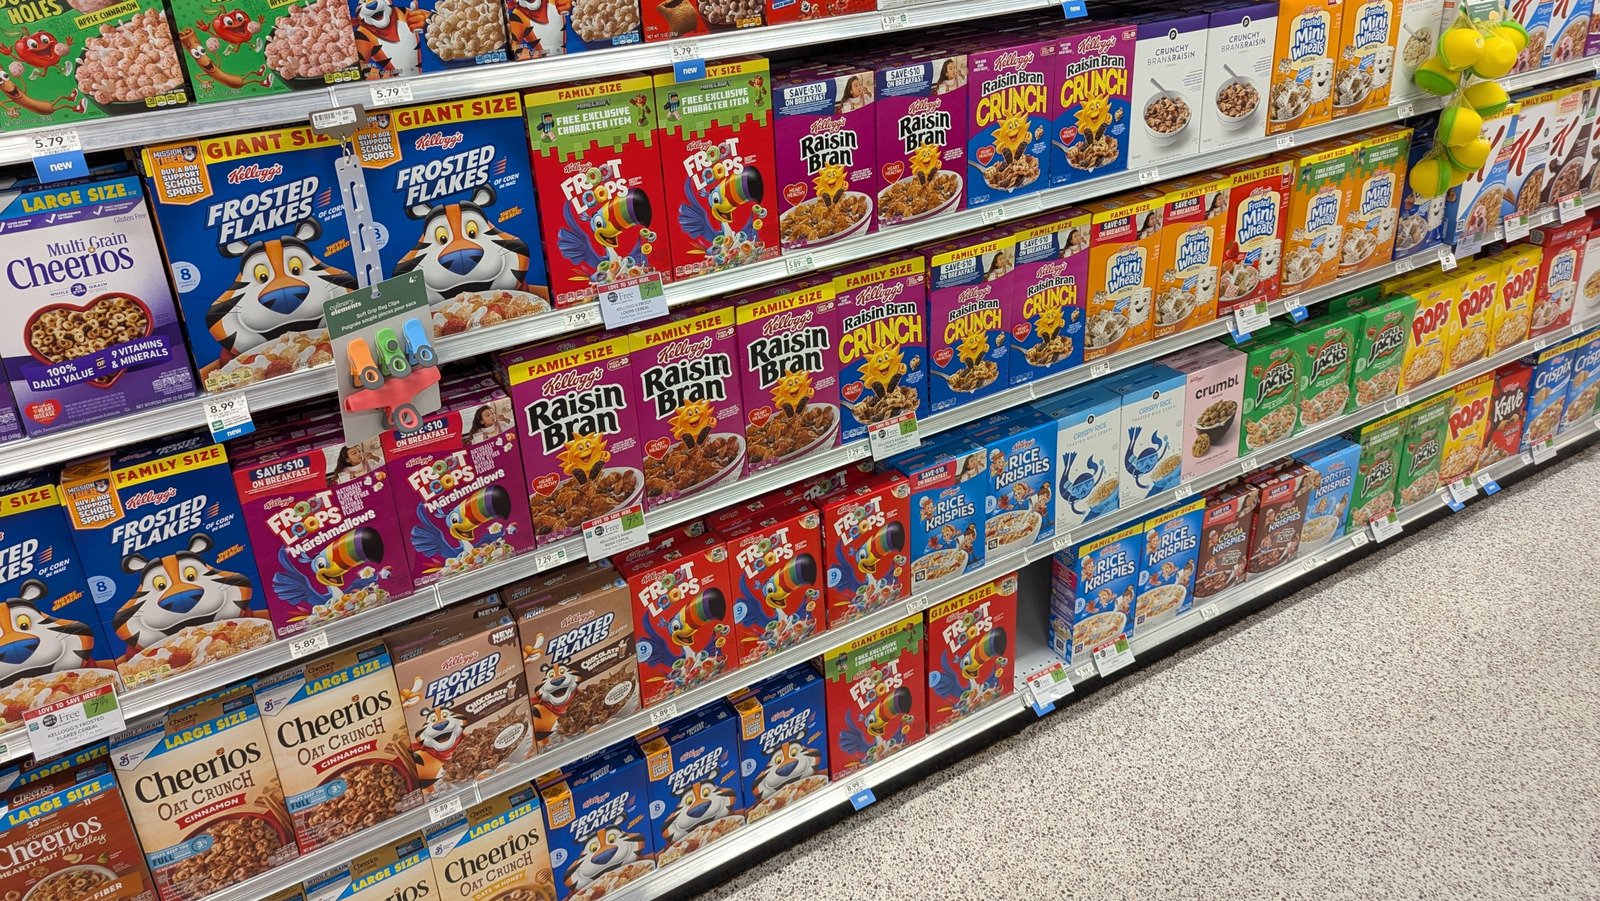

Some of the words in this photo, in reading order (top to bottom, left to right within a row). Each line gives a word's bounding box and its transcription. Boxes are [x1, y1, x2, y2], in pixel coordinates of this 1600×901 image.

[78, 14, 99, 27] APPLE
[99, 2, 138, 20] CINNAMON
[1365, 6, 1385, 17] Frosted
[1300, 16, 1321, 28] Frosted
[1360, 13, 1387, 32] Mini
[1229, 31, 1260, 43] CRUNCHY
[1295, 25, 1325, 44] Mini
[1356, 29, 1387, 48] Wheats
[673, 46, 692, 57] 5.79
[1155, 44, 1189, 56] CRUNCHY
[1292, 41, 1325, 61] Wheats
[683, 66, 697, 75] new
[721, 65, 742, 77] SIZE
[891, 70, 906, 80] SAVE
[1067, 59, 1099, 77] Raisin
[1101, 55, 1124, 67] Bran
[558, 87, 596, 100] FAMILY
[599, 83, 622, 95] SIZE
[789, 87, 806, 98] SAVE
[808, 85, 822, 94] $10
[897, 76, 923, 87] BREAKFAST
[982, 75, 1017, 95] Raisin
[1018, 71, 1043, 85] Bran
[1060, 69, 1127, 107] CRUNCH
[376, 87, 400, 99] 5.79
[682, 95, 702, 106] FREE
[704, 88, 748, 102] EXCLUSIVE
[796, 93, 826, 105] BREAKFAST
[1540, 94, 1553, 104] SIZE
[398, 103, 463, 127] GIANT
[471, 96, 518, 120] SIZE
[682, 101, 728, 115] CHARACTER
[730, 96, 750, 107] ITEM
[976, 86, 1047, 128] CRUNCH
[557, 114, 580, 126] FREE
[582, 107, 631, 122] EXCLUSIVE
[557, 121, 608, 136] CHARACTER
[609, 116, 632, 127] ITEM
[899, 111, 950, 138] Raisin
[35, 136, 63, 148] 5.79
[207, 133, 281, 160] GIANT
[359, 136, 392, 147] SUPPORT
[361, 142, 393, 154] SCHOOL
[801, 130, 857, 158] Raisin
[905, 129, 947, 154] Bran
[152, 149, 182, 159] MISSION
[362, 150, 395, 162] SPORTS
[683, 137, 739, 177] FROOT
[50, 160, 72, 171] new
[161, 167, 174, 176] BUY
[183, 164, 199, 173] BOX
[396, 145, 495, 190] FROSTED
[692, 157, 744, 191] LOOPS
[1233, 170, 1261, 184] FAMILY
[1263, 166, 1279, 177] SIZE
[162, 170, 200, 183] SUPPORT
[164, 177, 202, 191] SCHOOL
[405, 165, 490, 207] FLAKES
[494, 178, 502, 186] OF
[503, 173, 520, 183] CORN
[560, 159, 621, 201] FROOT
[22, 190, 82, 213] LARGE
[87, 183, 127, 202] SIZE
[166, 185, 204, 198] SPORTS
[207, 176, 319, 226] FROSTED
[571, 179, 628, 215] LOOPS
[1248, 197, 1270, 210] Frosted
[114, 215, 134, 223] Gluten
[134, 212, 147, 221] Free
[218, 199, 313, 245] FLAKES
[1243, 207, 1274, 226] Mini
[1238, 222, 1274, 244] Wheats
[47, 237, 86, 257] Multi
[89, 232, 128, 252] Grain
[951, 249, 976, 261] FAMILY
[979, 243, 997, 254] SIZE
[7, 246, 134, 290] Cheerios
[846, 270, 887, 288] FAMILY
[890, 263, 912, 277] SIZE
[1503, 266, 1537, 311] POPS
[329, 299, 354, 311] culinary
[331, 301, 362, 316] elements
[356, 311, 367, 319] Soft
[367, 307, 377, 316] Grip
[378, 303, 388, 312] Bag
[388, 299, 400, 308] Clips
[378, 310, 394, 319] pinces
[394, 305, 405, 313] pour
[752, 298, 795, 317] FAMILY
[798, 290, 822, 305] SIZE
[949, 304, 976, 321] Raisin
[979, 299, 998, 310] Bran
[1458, 282, 1497, 328] POPS
[567, 313, 586, 323] 7.99
[844, 306, 885, 331] Raisin
[886, 301, 916, 316] Bran
[944, 309, 1002, 343] CRUNCH
[1412, 300, 1452, 346] POPS
[645, 326, 691, 345] FAMILY
[695, 315, 722, 331] SIZE
[839, 315, 922, 360] CRUNCH
[1380, 326, 1399, 342] APPLE
[111, 349, 118, 358] 9
[118, 339, 163, 357] VITAMINS
[111, 359, 119, 368] &
[120, 348, 168, 367] MINERALS
[749, 327, 828, 371] Raisin
[47, 362, 77, 377] 100%
[97, 360, 105, 368] OF
[528, 355, 581, 376] FAMILY
[584, 345, 613, 361] SIZE
[32, 376, 59, 389] DAILY
[62, 367, 95, 382] VALUE
[644, 354, 729, 400] Raisin
[1267, 363, 1288, 379] APPLE
[1535, 359, 1572, 389] Crispix
[1195, 374, 1239, 400] crumbl
[1256, 368, 1294, 408] JACKS
[210, 401, 235, 414] 8.99
[527, 386, 624, 432] Raisin
[226, 427, 241, 437] new
[1073, 425, 1094, 440] CRISPY
[1095, 421, 1108, 433] RICE
[396, 440, 407, 448] ON
[256, 464, 282, 478] SAVE
[287, 459, 304, 471] $10
[1008, 447, 1040, 470] RICE
[117, 460, 177, 484] FAMILY
[252, 479, 265, 488] ON
[266, 467, 311, 486] BREAKFAST
[996, 458, 1050, 490] KRISPIES
[425, 469, 505, 514] Marshmallows
[112, 495, 207, 544] FROSTED
[122, 512, 202, 556] FLAKES
[290, 509, 376, 558] Marshmallows
[1162, 528, 1187, 547] RICE
[1218, 528, 1243, 543] COCOA
[1149, 536, 1196, 566] KRISPIES
[931, 596, 966, 619] GIANT
[492, 628, 514, 641] NEW
[294, 639, 315, 651] 5.89
[552, 629, 610, 663] FLAKES
[305, 675, 348, 696] LARGE
[432, 668, 496, 708] FLAKES
[38, 705, 54, 715] LOVE
[66, 696, 81, 706] SAVE
[277, 690, 392, 748] Cheerios
[57, 731, 77, 742] FLAKES
[78, 724, 99, 736] CEREAL
[165, 725, 213, 749] LARGE
[321, 744, 371, 769] CINNAMON
[135, 741, 261, 803] Cheerios
[844, 781, 860, 793] 8.99
[9, 800, 61, 826] LARGE
[469, 817, 506, 839] LARGE
[40, 853, 58, 865] NUT
[444, 828, 540, 883] Cheerios
